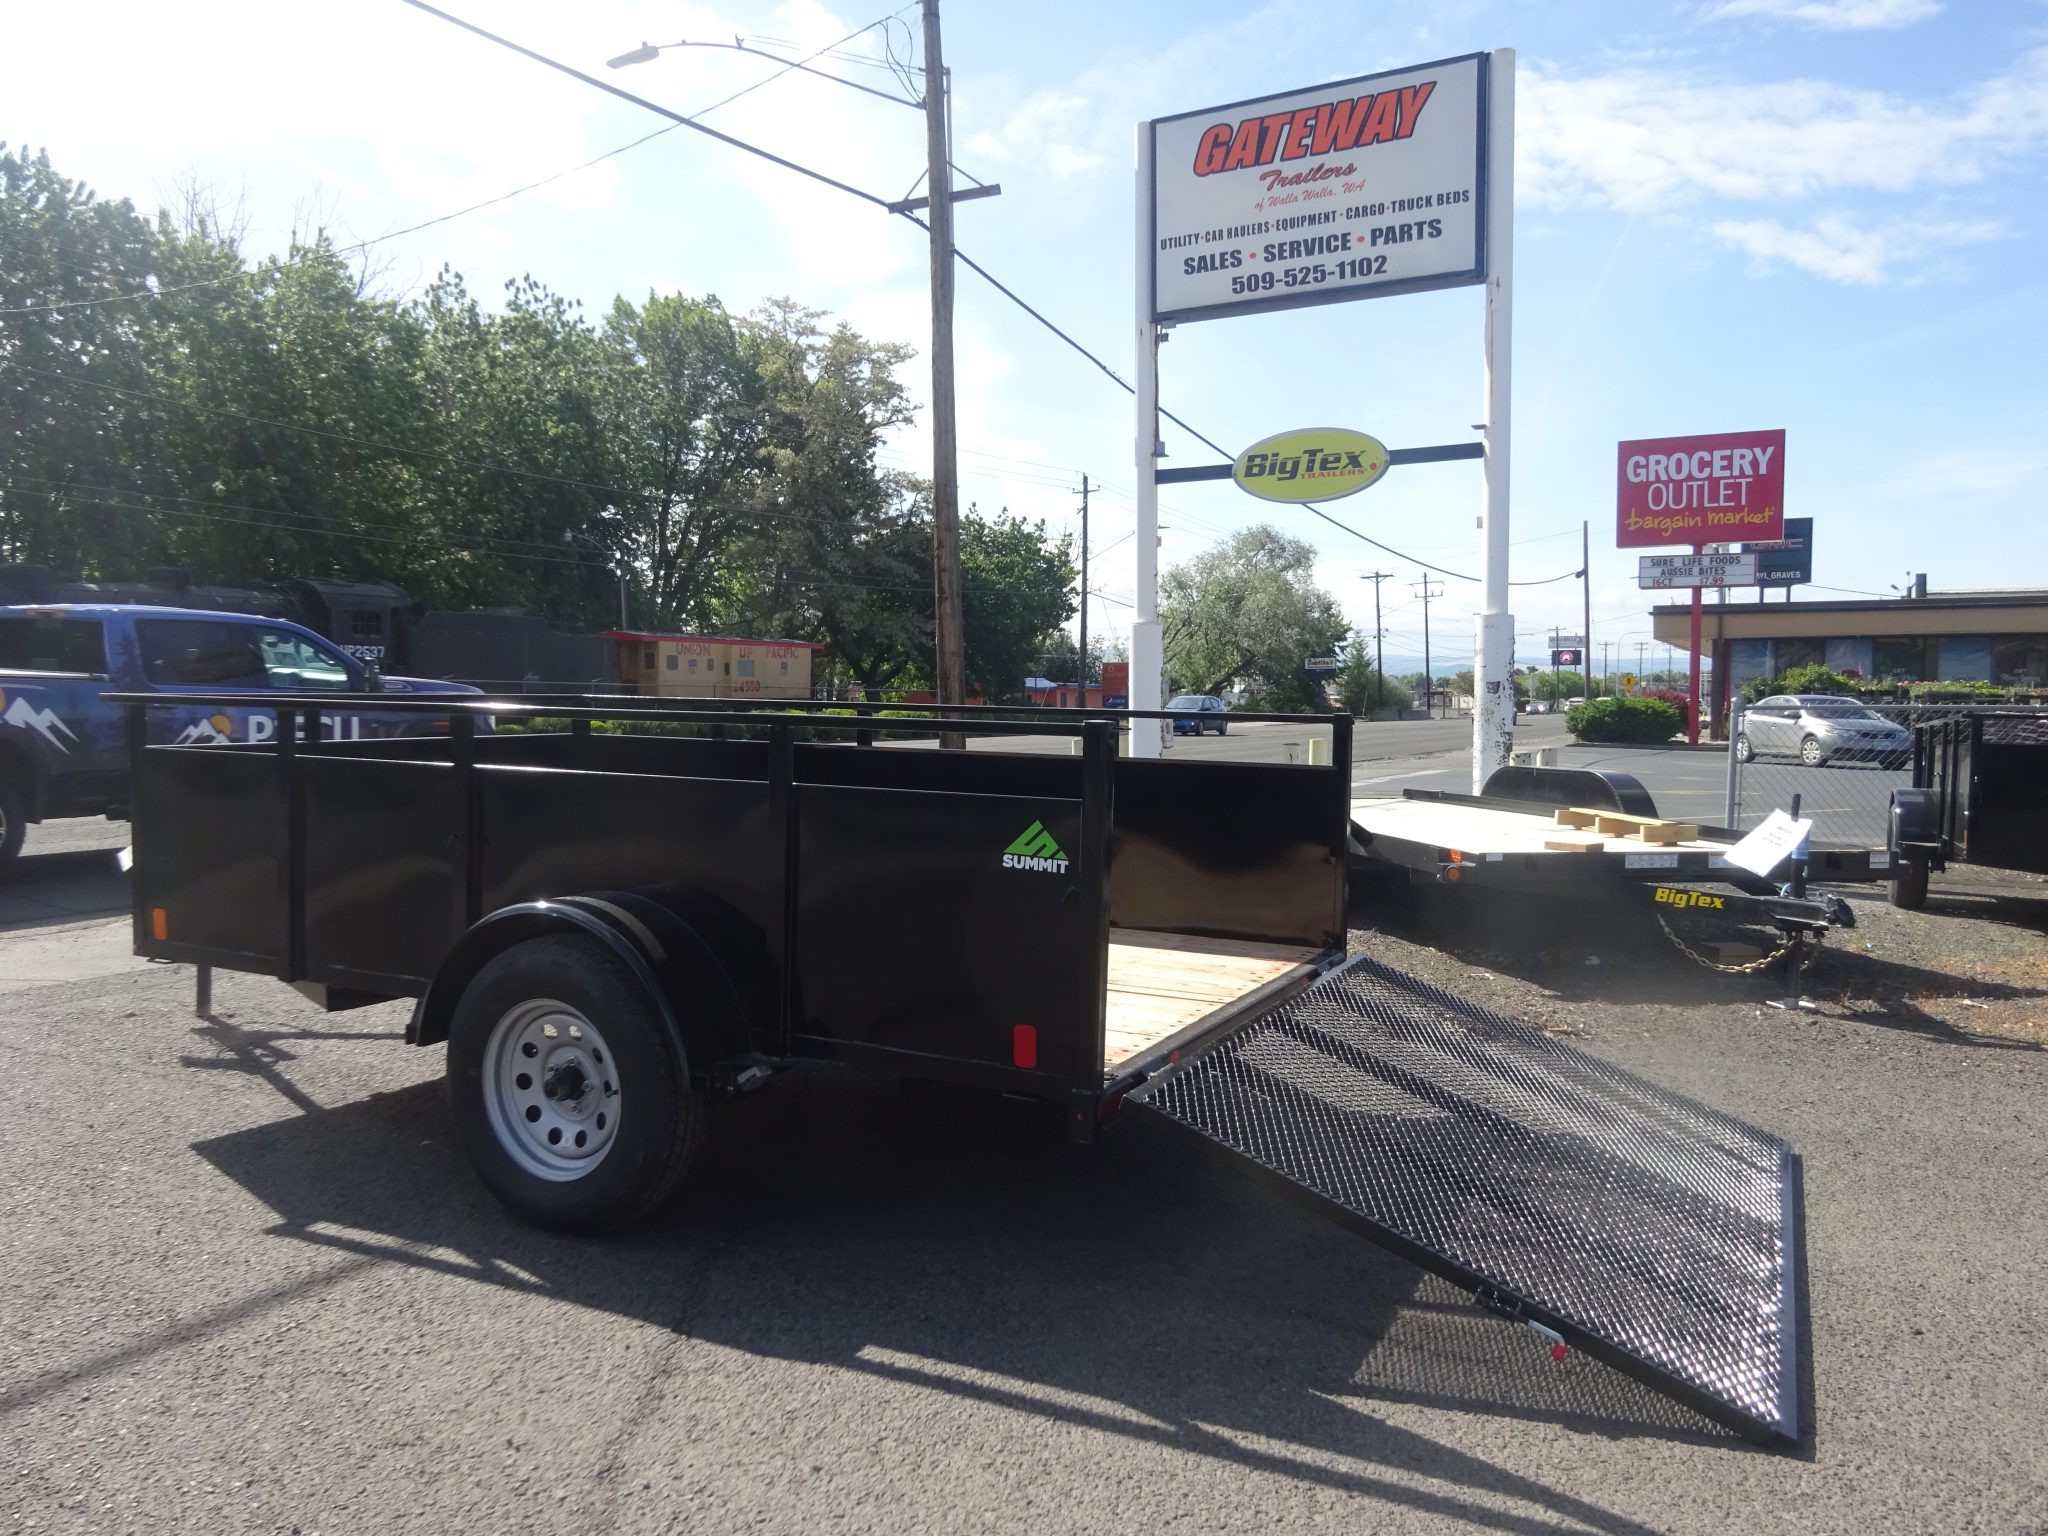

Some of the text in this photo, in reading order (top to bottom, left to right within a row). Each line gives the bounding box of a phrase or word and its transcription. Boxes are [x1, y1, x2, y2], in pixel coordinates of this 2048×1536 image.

[1193, 81, 1437, 177] GATEWAY
[1259, 162, 1357, 192] Trailers
[1254, 199, 1265, 213] of
[1268, 193, 1299, 208] Walla
[1342, 179, 1366, 194] WA
[1160, 190, 1470, 250] UTILITY CAR HAULERS EQUIPMENT CARGO TRUCK BEDS
[1183, 219, 1442, 275] SALES SERVICE PARTS
[1231, 255, 1387, 295] 509-525-1102
[1300, 469, 1365, 479] TRAILERS
[1626, 446, 1775, 483] GROCERY
[1647, 477, 1753, 511] OUTLET
[1625, 507, 1774, 536] bargain market
[1651, 556, 1741, 567] SURE LIFE FOODS
[1660, 566, 1726, 577] AUSSIE BITES
[1770, 571, 1801, 579] GRAVES
[1652, 578, 1673, 586] 16CT
[765, 647, 800, 659] PACIFIC
[1002, 854, 1069, 873] SUMMIT
[1654, 887, 1725, 909] BigTex
